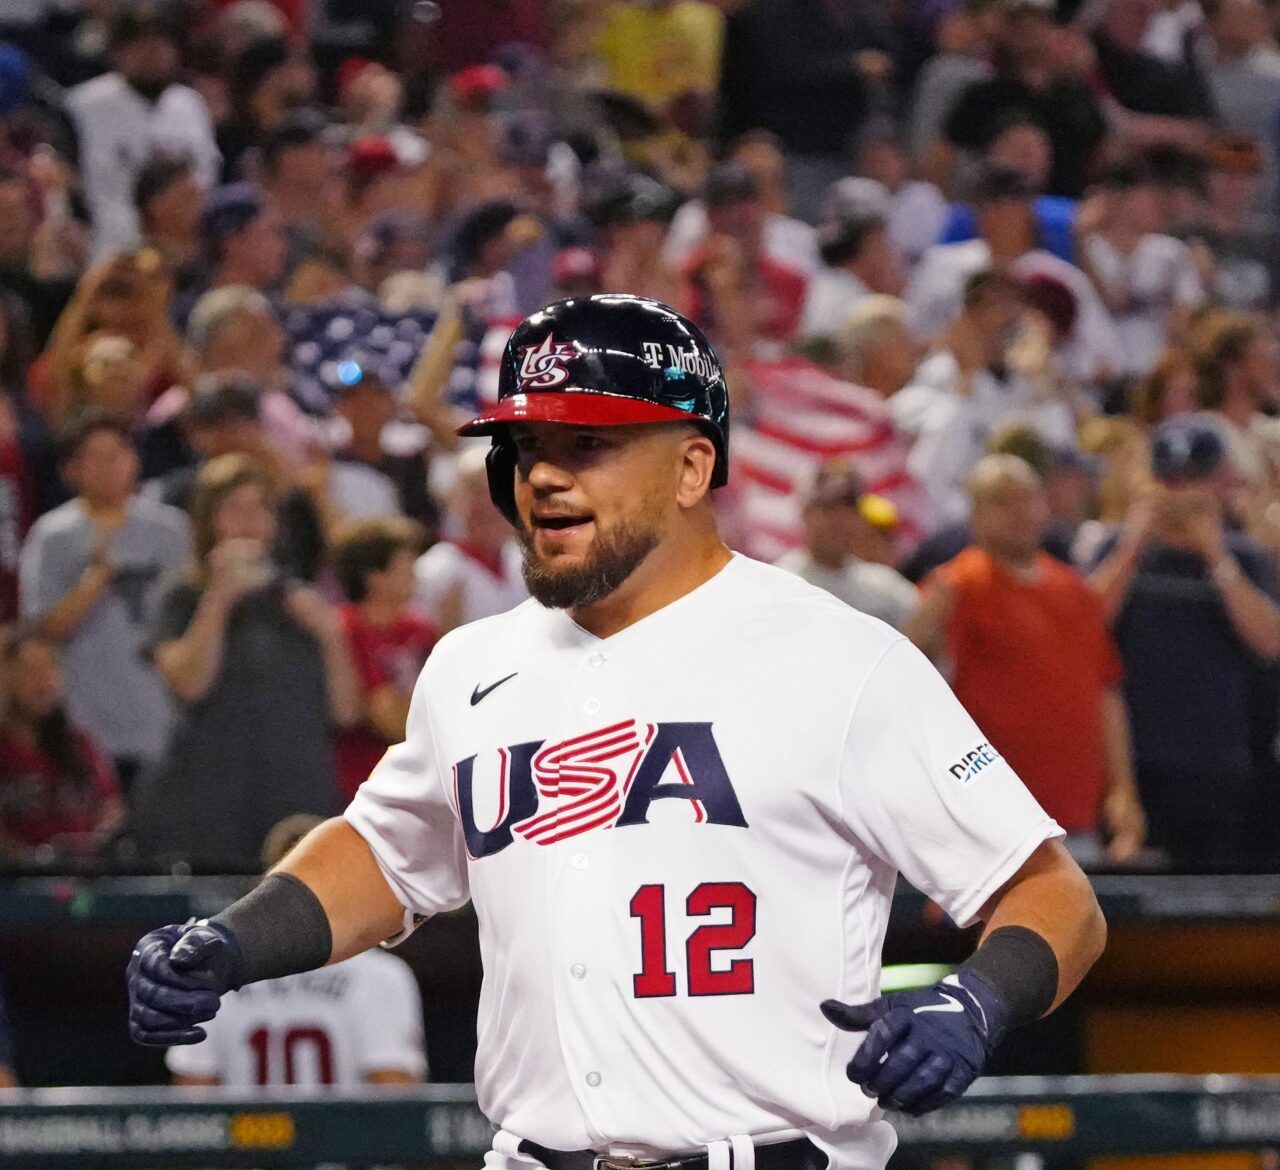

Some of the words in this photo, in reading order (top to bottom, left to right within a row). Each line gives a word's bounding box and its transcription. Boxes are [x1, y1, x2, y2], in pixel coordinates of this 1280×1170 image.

[452, 718, 750, 862] USA
[948, 742, 999, 783] DIRE
[629, 881, 758, 999] 12
